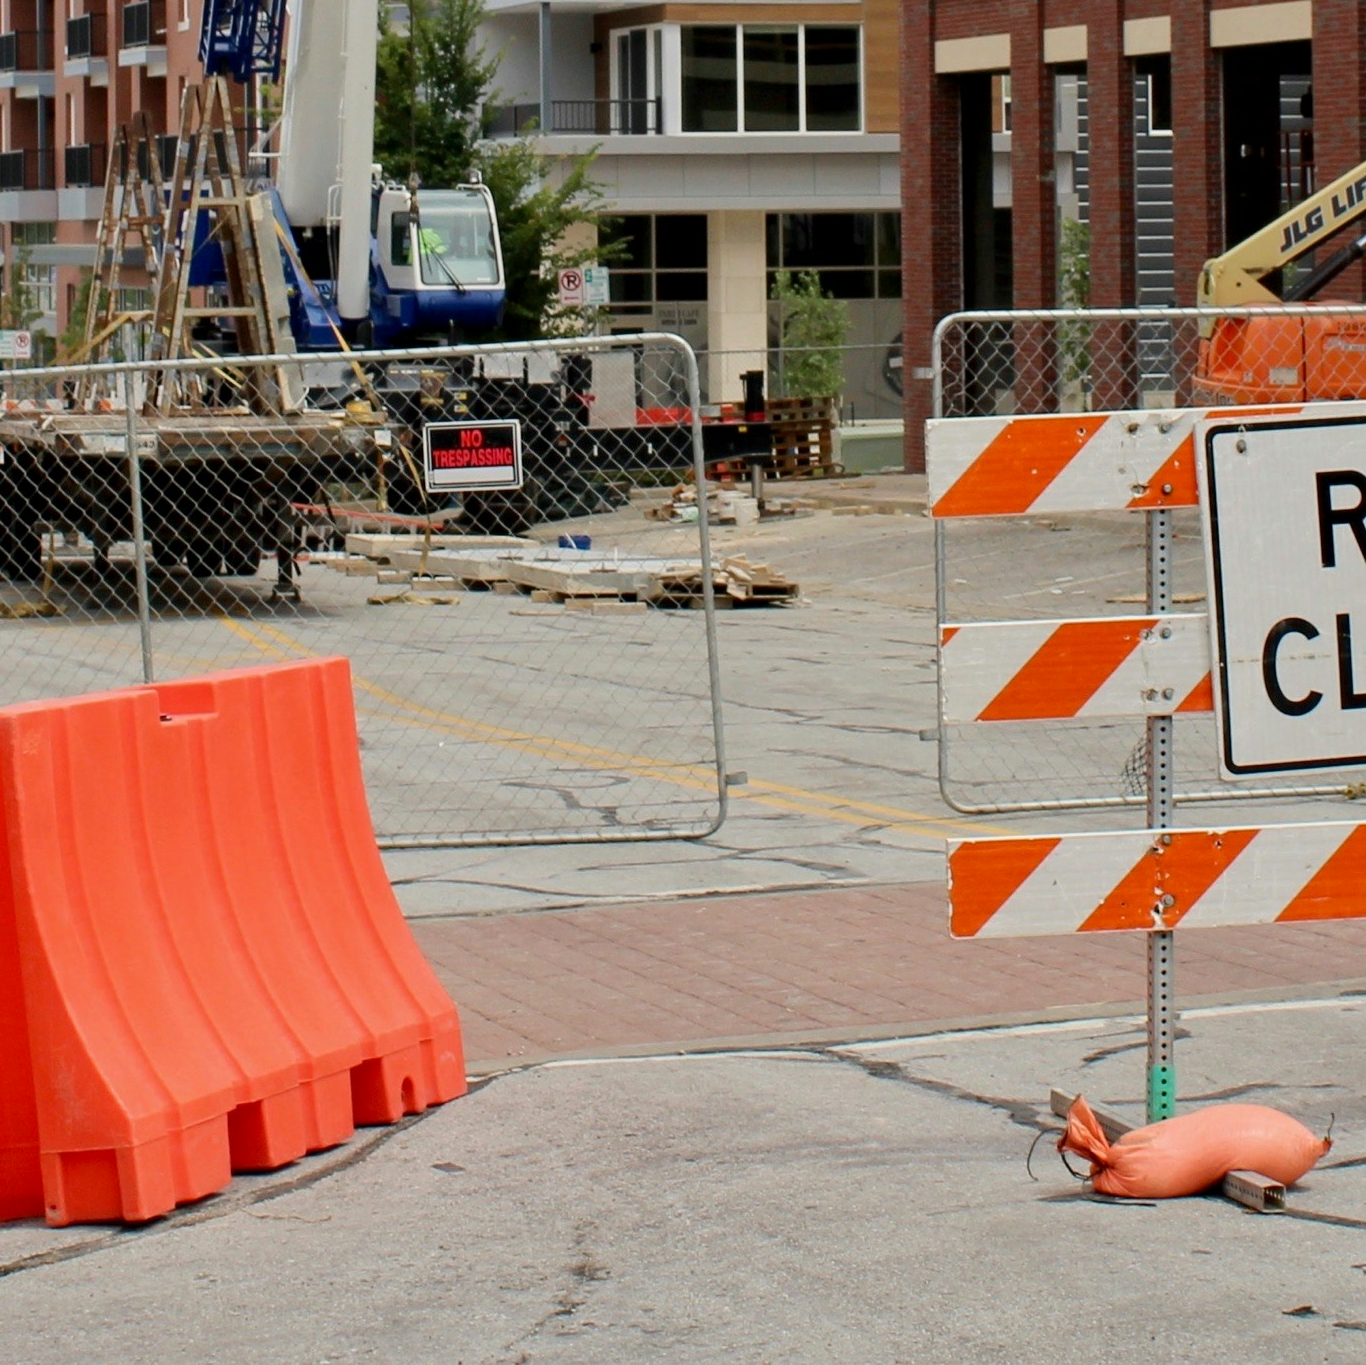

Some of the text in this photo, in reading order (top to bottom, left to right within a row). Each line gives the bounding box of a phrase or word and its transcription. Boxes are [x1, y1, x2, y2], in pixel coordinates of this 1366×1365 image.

[1280, 206, 1324, 254] JLG
[460, 429, 482, 447] NO
[433, 447, 512, 467] TRESPASSING
